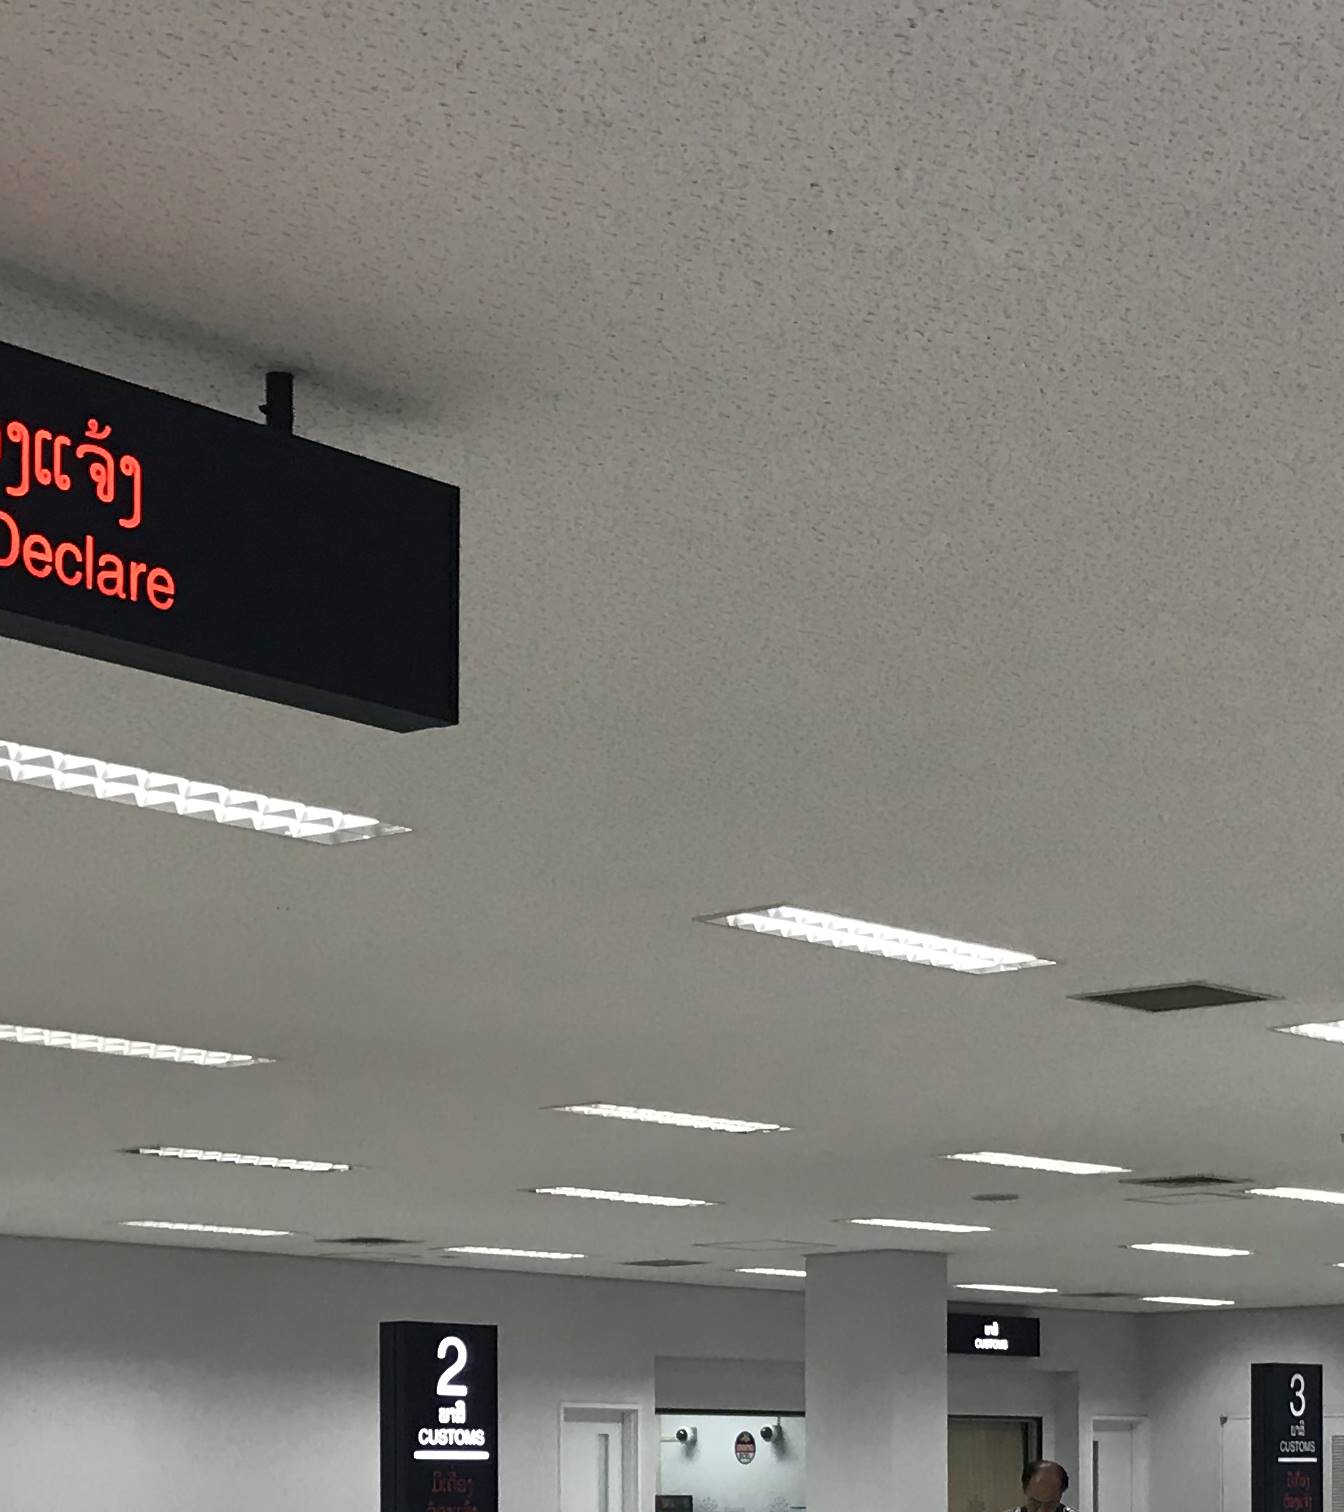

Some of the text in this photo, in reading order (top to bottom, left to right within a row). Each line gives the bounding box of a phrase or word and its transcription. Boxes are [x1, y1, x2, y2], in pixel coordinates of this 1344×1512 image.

[436, 1336, 468, 1397] 2
[1289, 1373, 1306, 1417] 3
[418, 1427, 486, 1446] CUSTOMS
[1279, 1440, 1316, 1453] CUSTOMS
